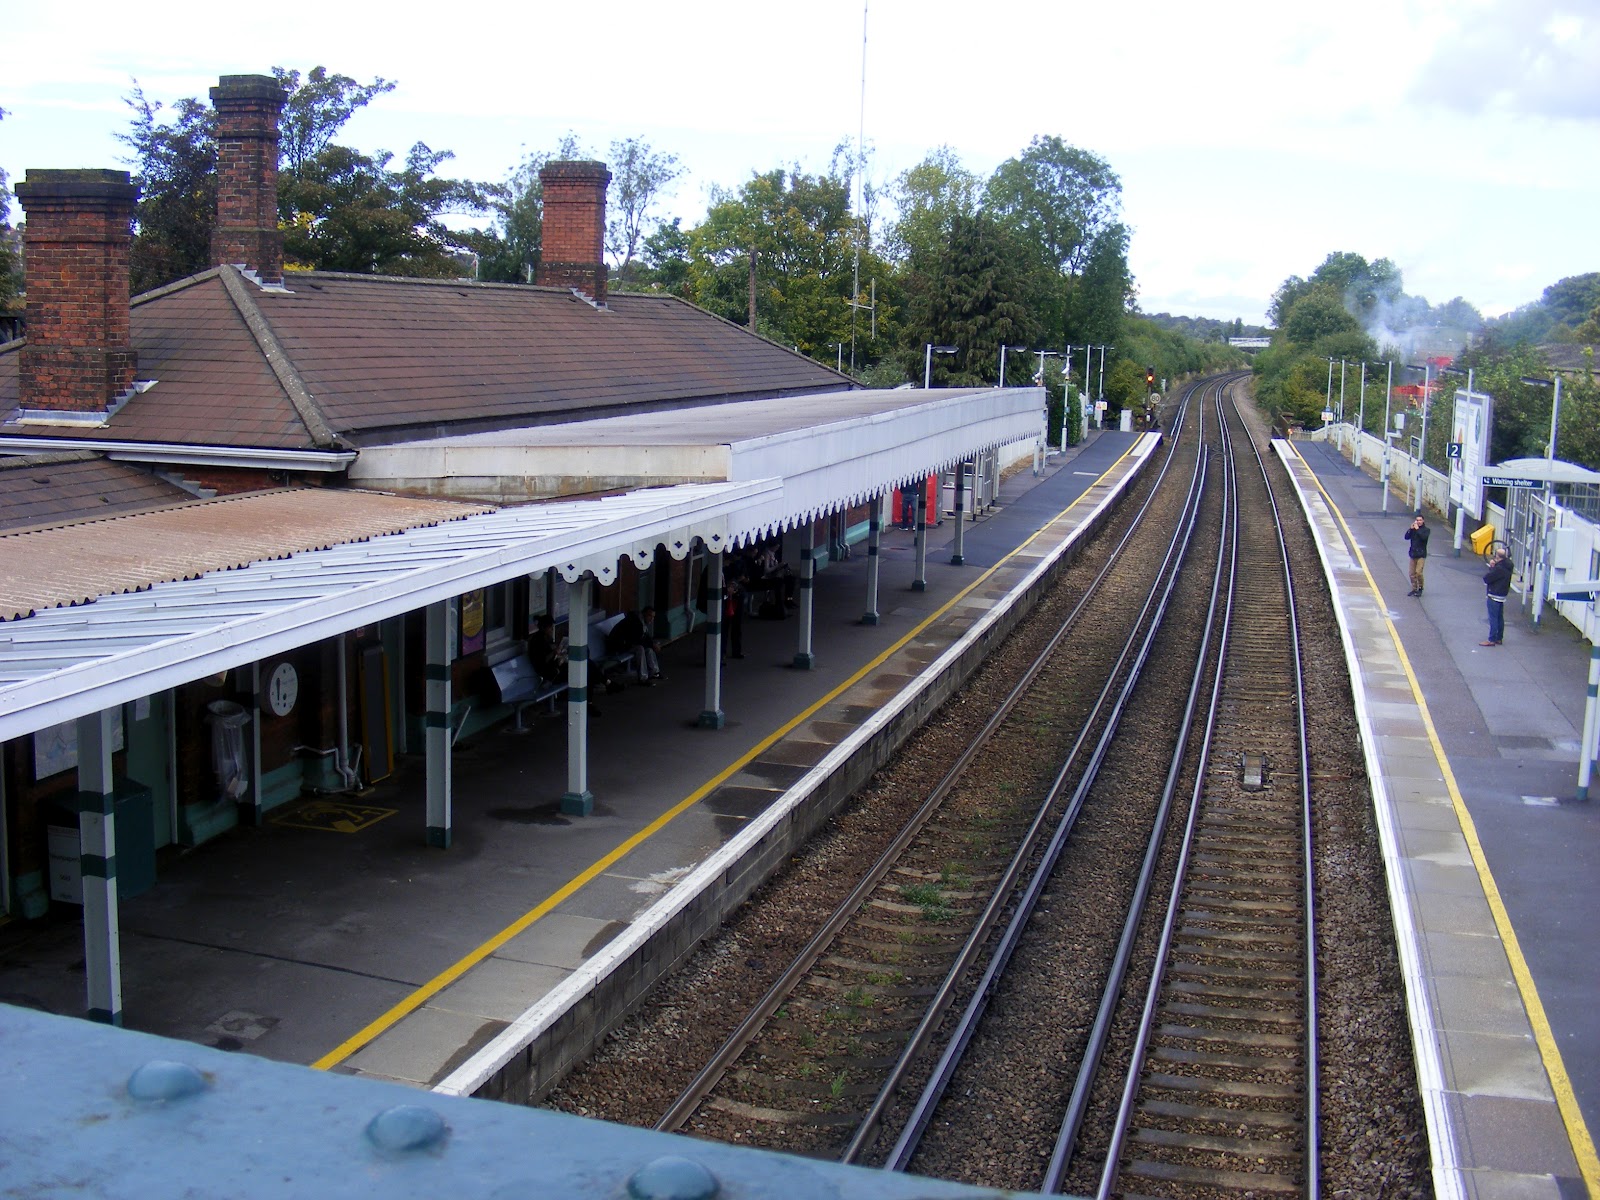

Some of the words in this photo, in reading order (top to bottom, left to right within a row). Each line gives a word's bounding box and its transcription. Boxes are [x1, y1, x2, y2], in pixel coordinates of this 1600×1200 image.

[1451, 445, 1458, 457] 2
[1492, 477, 1514, 486] Waiting
[1514, 479, 1533, 487] shelter
